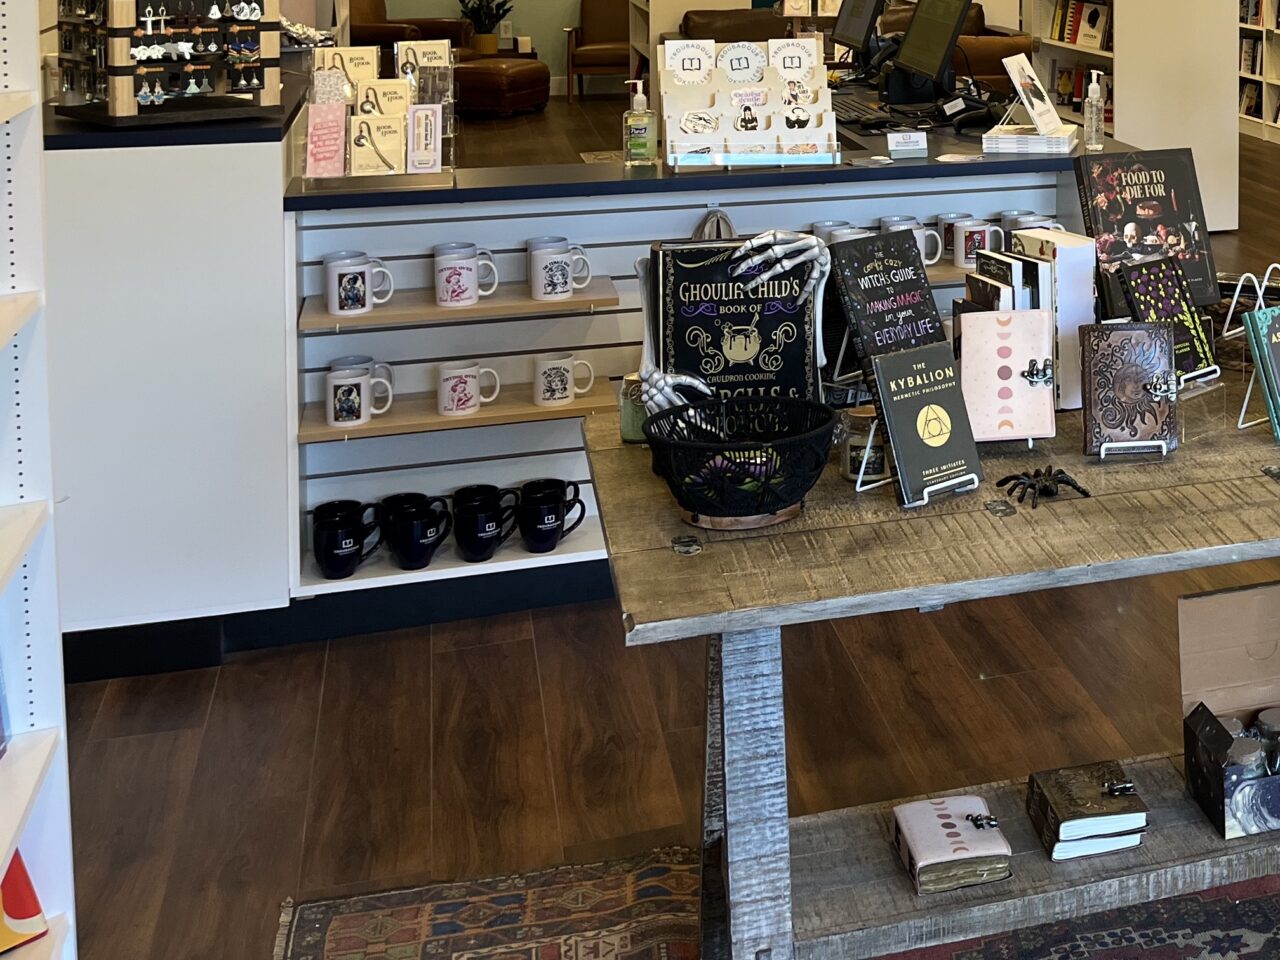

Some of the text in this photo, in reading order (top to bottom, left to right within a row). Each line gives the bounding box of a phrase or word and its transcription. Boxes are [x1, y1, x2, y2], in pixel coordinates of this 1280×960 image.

[671, 43, 713, 60] TROUBADOUR
[718, 43, 760, 62] TROUBADOUR
[772, 42, 813, 58] TROUBADOUR
[1121, 170, 1165, 186] FOOD TO
[1126, 183, 1166, 199] DIE FOR
[890, 266, 918, 284] GUIDE
[719, 304, 763, 314] BOOK OF
[866, 290, 925, 315] MAKING MAGIC
[874, 317, 935, 347] EVERYDAY LIFE
[912, 362, 926, 370] THE
[707, 372, 777, 384] CAULDRON COOKING
[889, 366, 954, 392] KYBALION
[892, 381, 957, 402] HERMETIC PHILOSOPHY
[922, 459, 966, 476] THREE INITIATES
